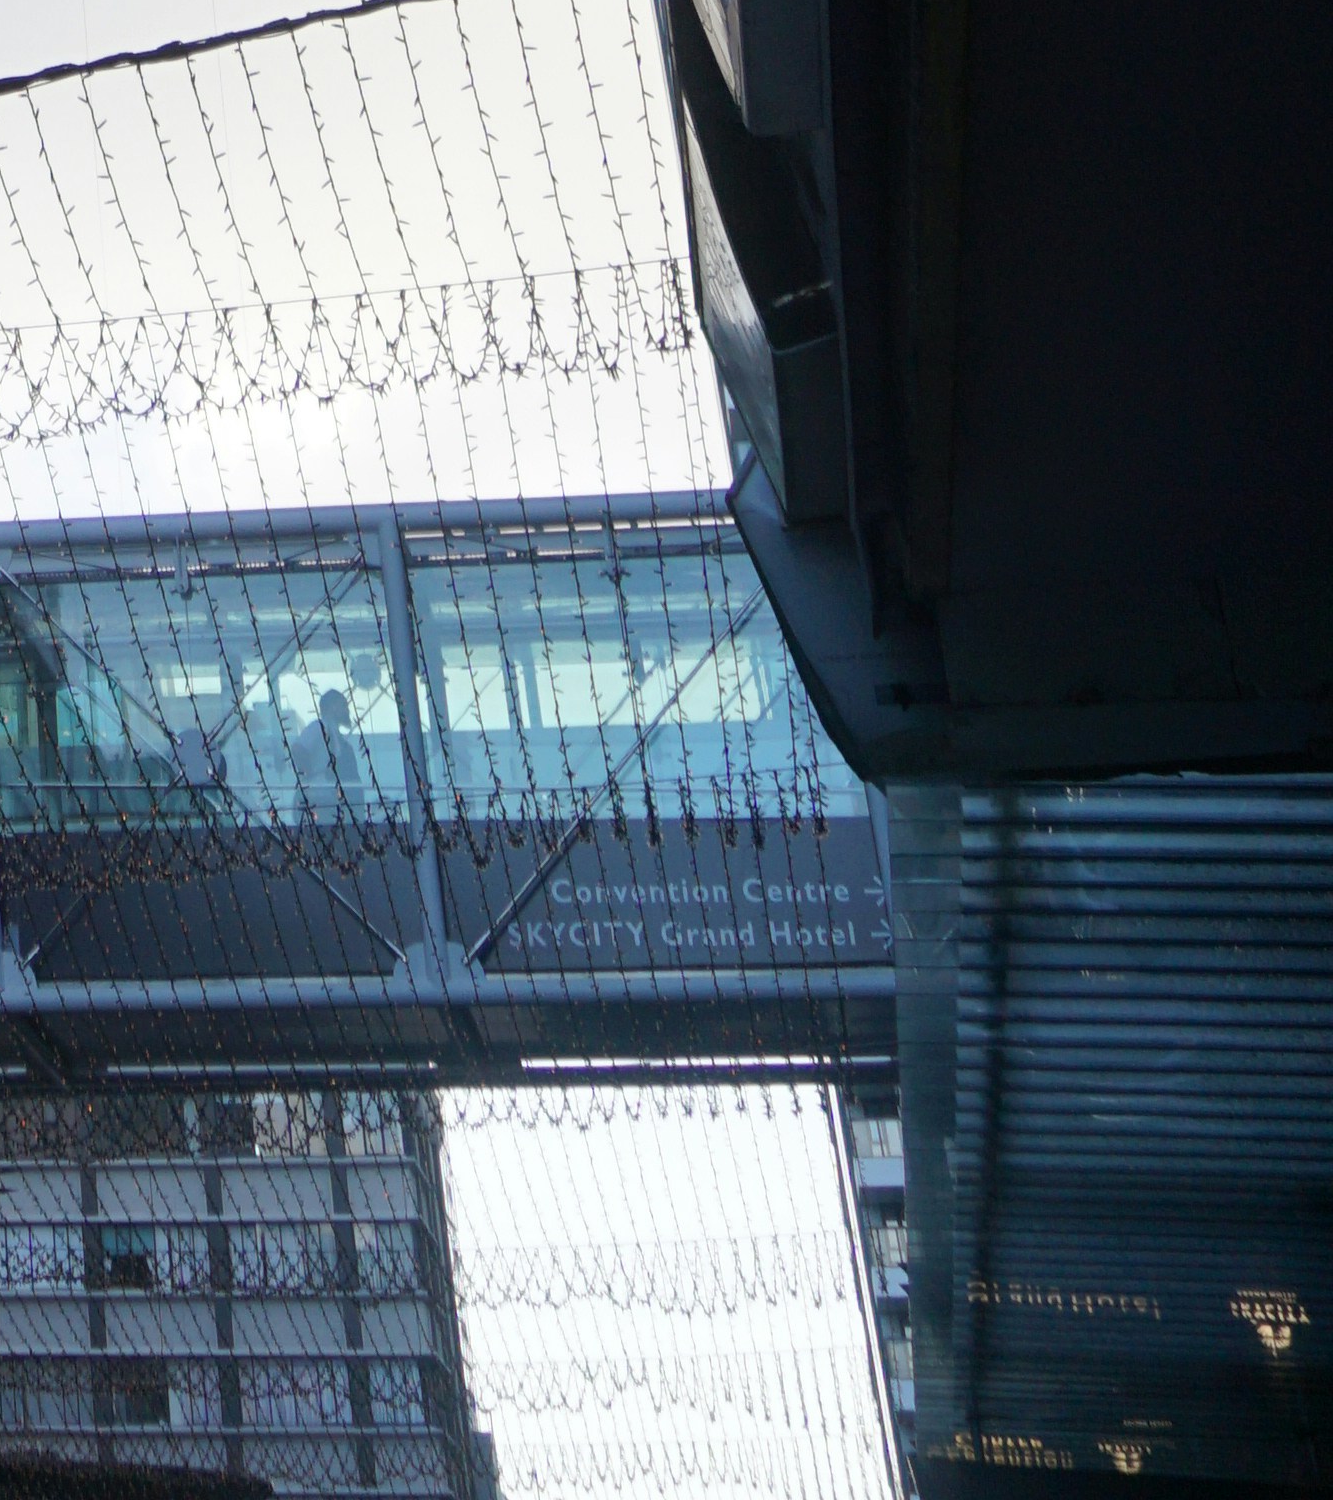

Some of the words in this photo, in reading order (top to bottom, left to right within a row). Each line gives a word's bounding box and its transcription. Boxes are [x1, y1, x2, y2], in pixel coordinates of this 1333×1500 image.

[550, 877, 730, 904] Convention
[742, 877, 850, 904] Centre
[507, 921, 645, 948] SKYCITY
[660, 920, 755, 948] Grand
[769, 920, 856, 948] Hotel
